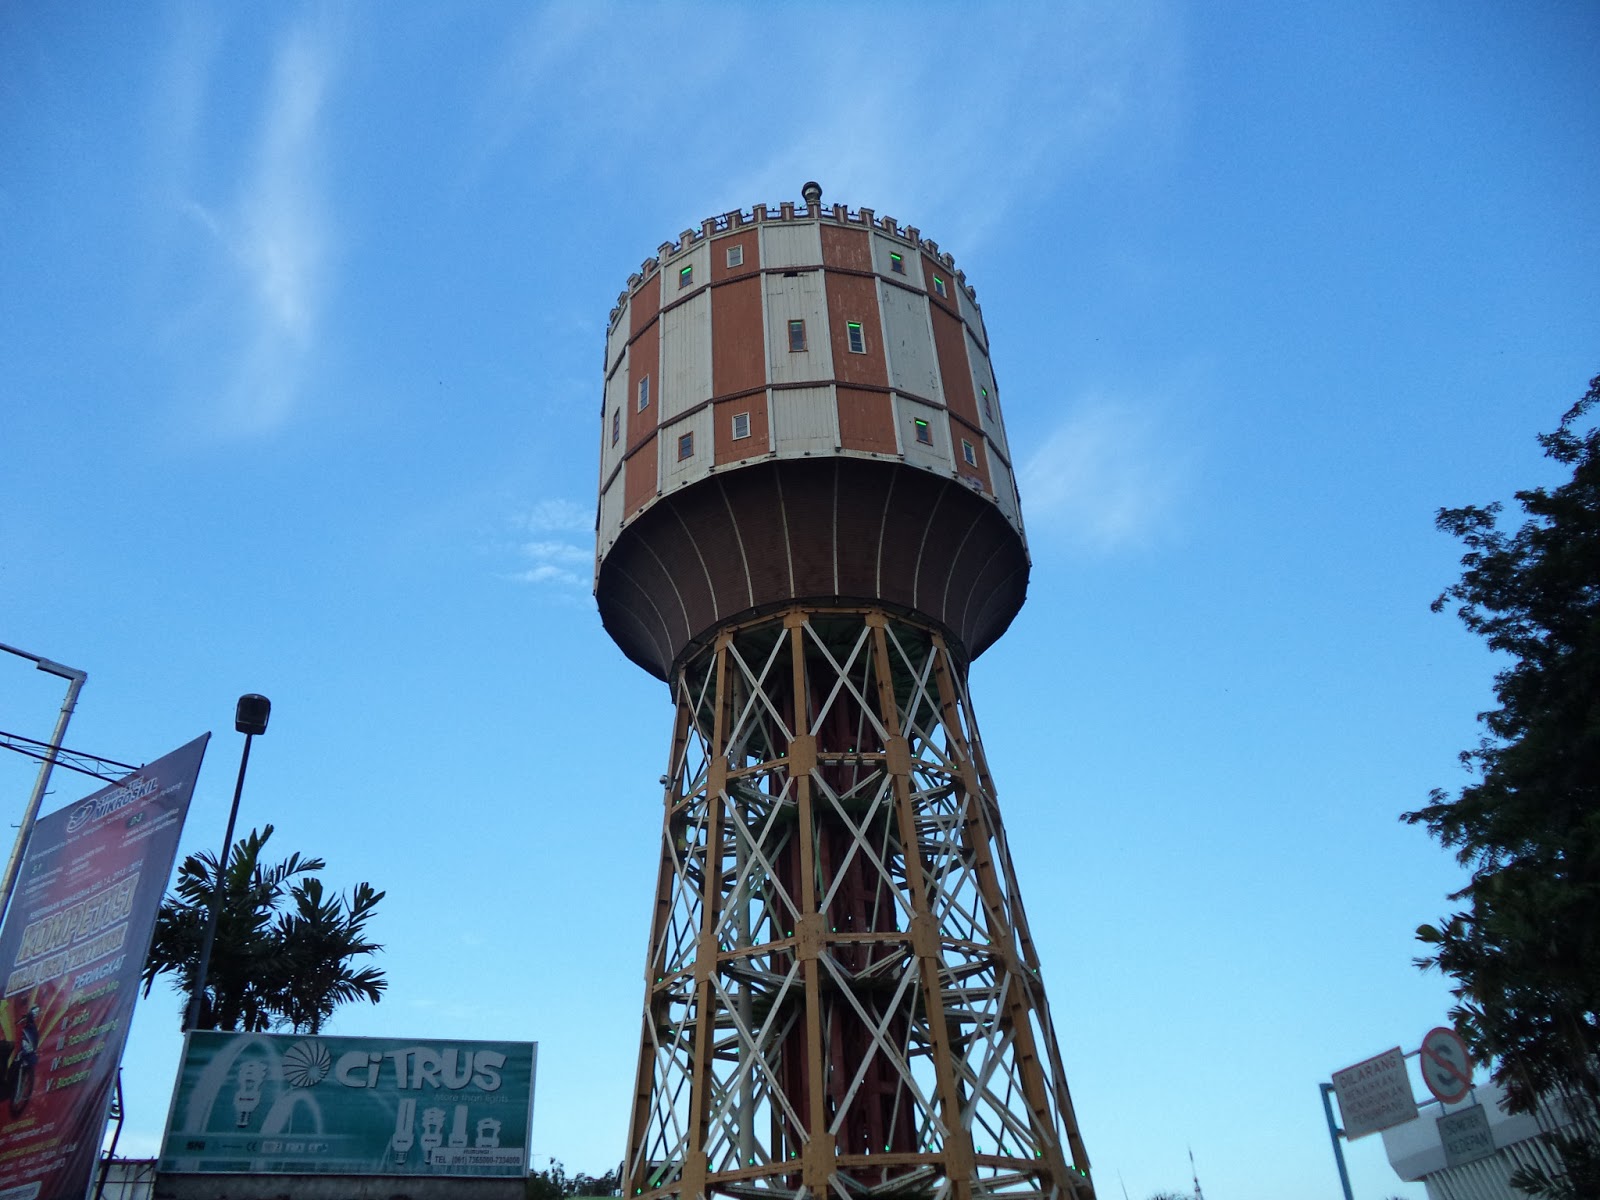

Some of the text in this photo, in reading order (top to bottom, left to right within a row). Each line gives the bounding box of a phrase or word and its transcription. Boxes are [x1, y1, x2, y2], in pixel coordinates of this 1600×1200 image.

[93, 778, 158, 820] MIKROSKIL
[15, 872, 139, 966] KOMPETISI
[72, 954, 126, 991] PERINGKAT
[1339, 1055, 1398, 1088] DILARANG
